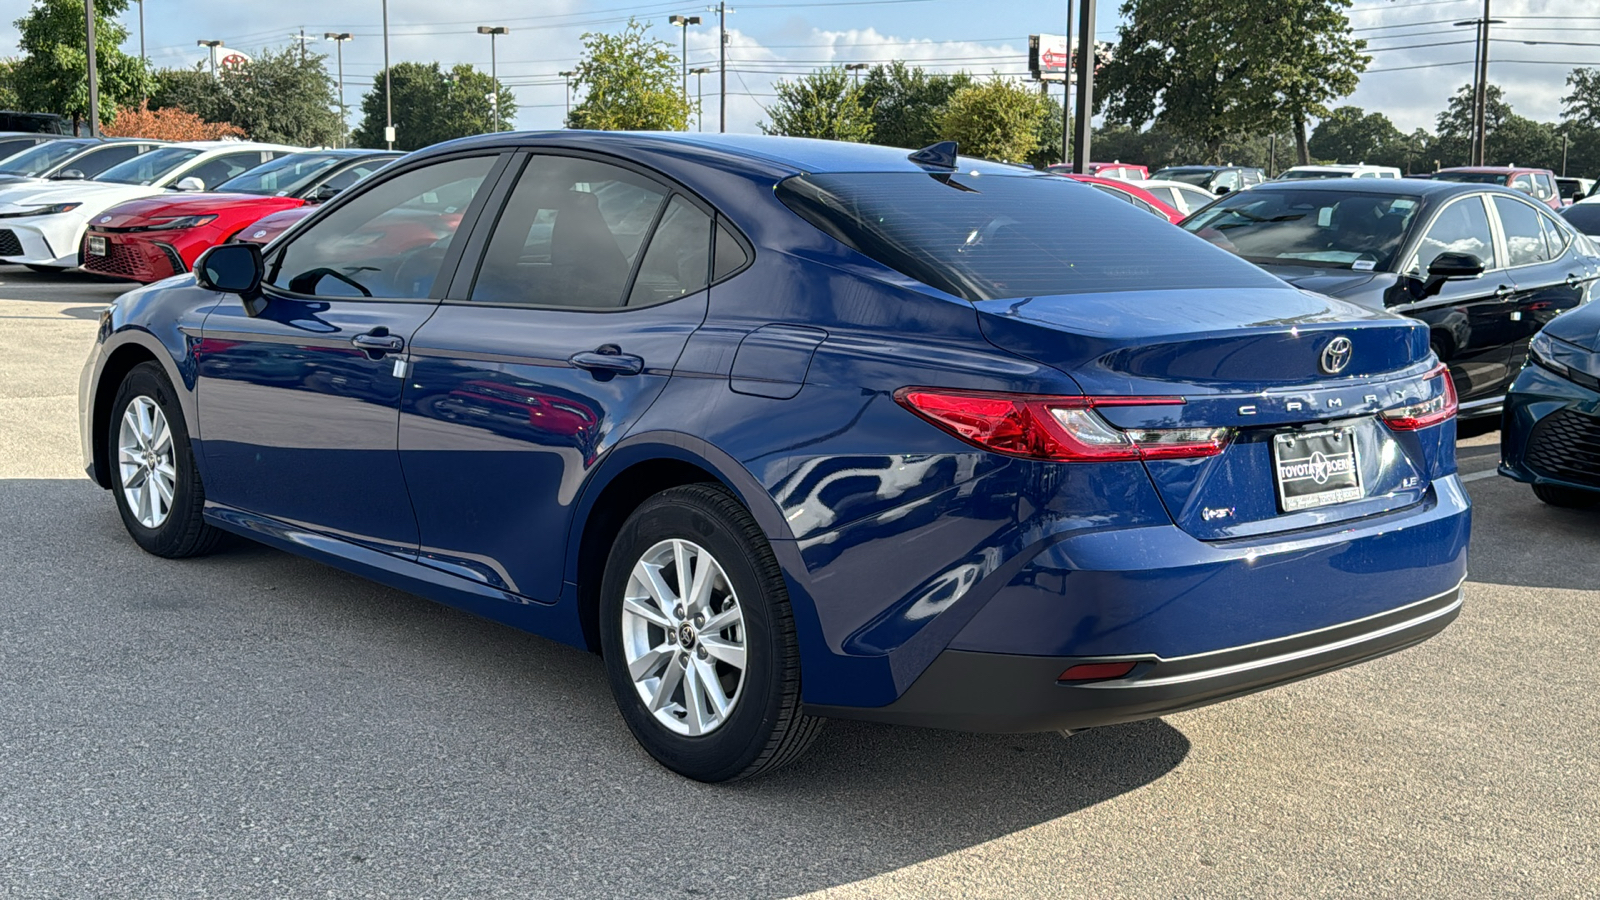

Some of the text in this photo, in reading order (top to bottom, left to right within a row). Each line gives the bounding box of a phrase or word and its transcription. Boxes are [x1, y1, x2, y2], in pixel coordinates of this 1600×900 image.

[1238, 389, 1406, 415] CAMRY
[1280, 464, 1315, 478] TOYOTA
[1403, 477, 1417, 487] LE
